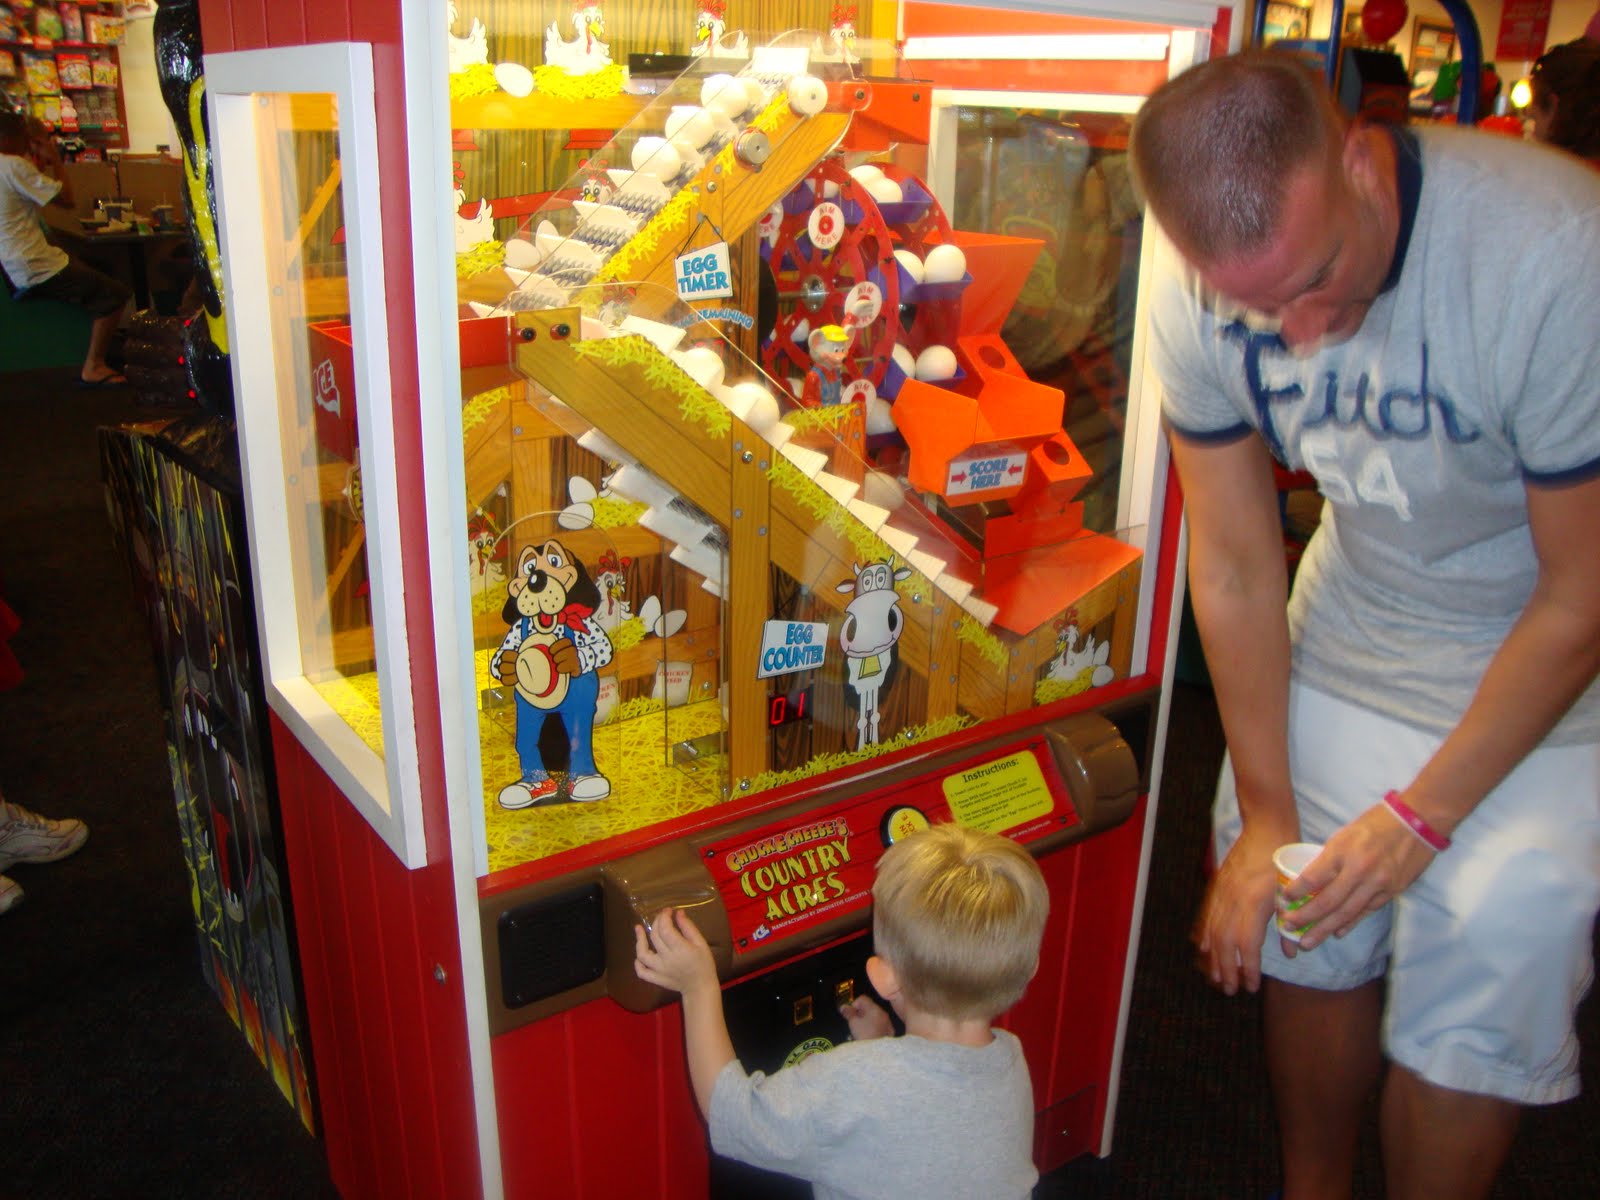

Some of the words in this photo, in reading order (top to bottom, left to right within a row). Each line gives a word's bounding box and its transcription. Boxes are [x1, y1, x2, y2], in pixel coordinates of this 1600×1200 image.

[819, 205, 835, 216] AIM
[815, 234, 837, 246] HERE
[683, 253, 717, 276] EGG
[678, 271, 729, 293] TIMER
[858, 286, 874, 295] AIM
[697, 309, 753, 329] REMAINING
[968, 458, 1008, 476] SCORE
[971, 473, 1001, 489] HERE
[786, 623, 813, 645] EGG
[764, 645, 824, 671] COUNTER
[771, 692, 805, 724] 01
[962, 758, 1019, 783] Instructions:
[726, 838, 777, 872] CHUCK
[785, 817, 849, 848] CHEESE'S
[741, 837, 850, 897] COUNTRY
[766, 872, 845, 921] ACRES
[772, 913, 809, 930] MANUFACTURED
